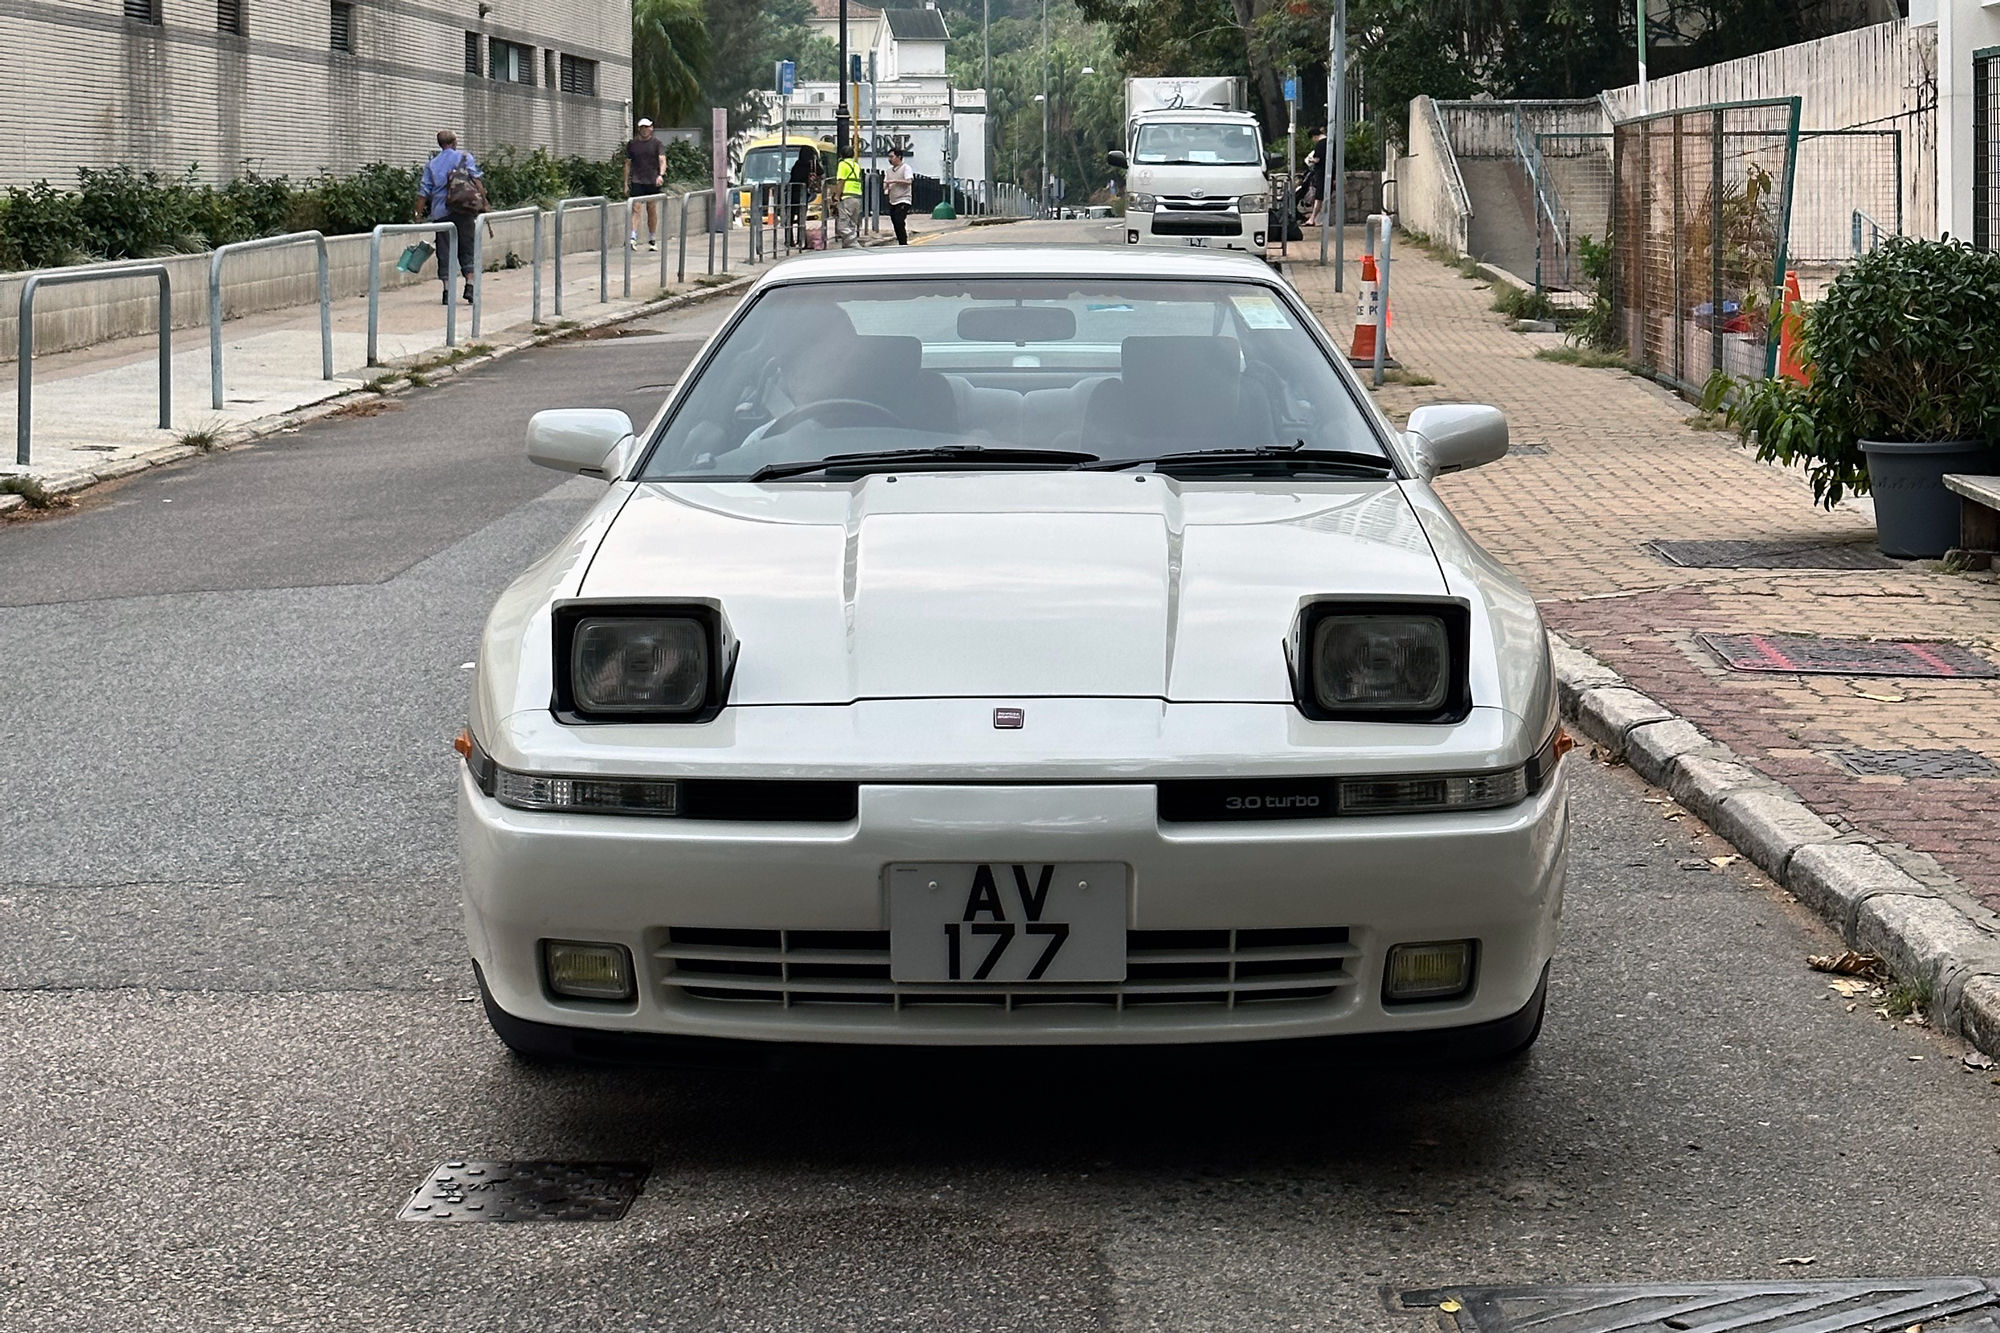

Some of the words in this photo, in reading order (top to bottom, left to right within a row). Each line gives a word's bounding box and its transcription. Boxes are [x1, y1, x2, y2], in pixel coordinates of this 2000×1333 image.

[1225, 796, 1261, 809] 3.0
[1264, 795, 1320, 808] turbo
[963, 864, 1056, 922] AV
[944, 923, 1070, 980] 177
